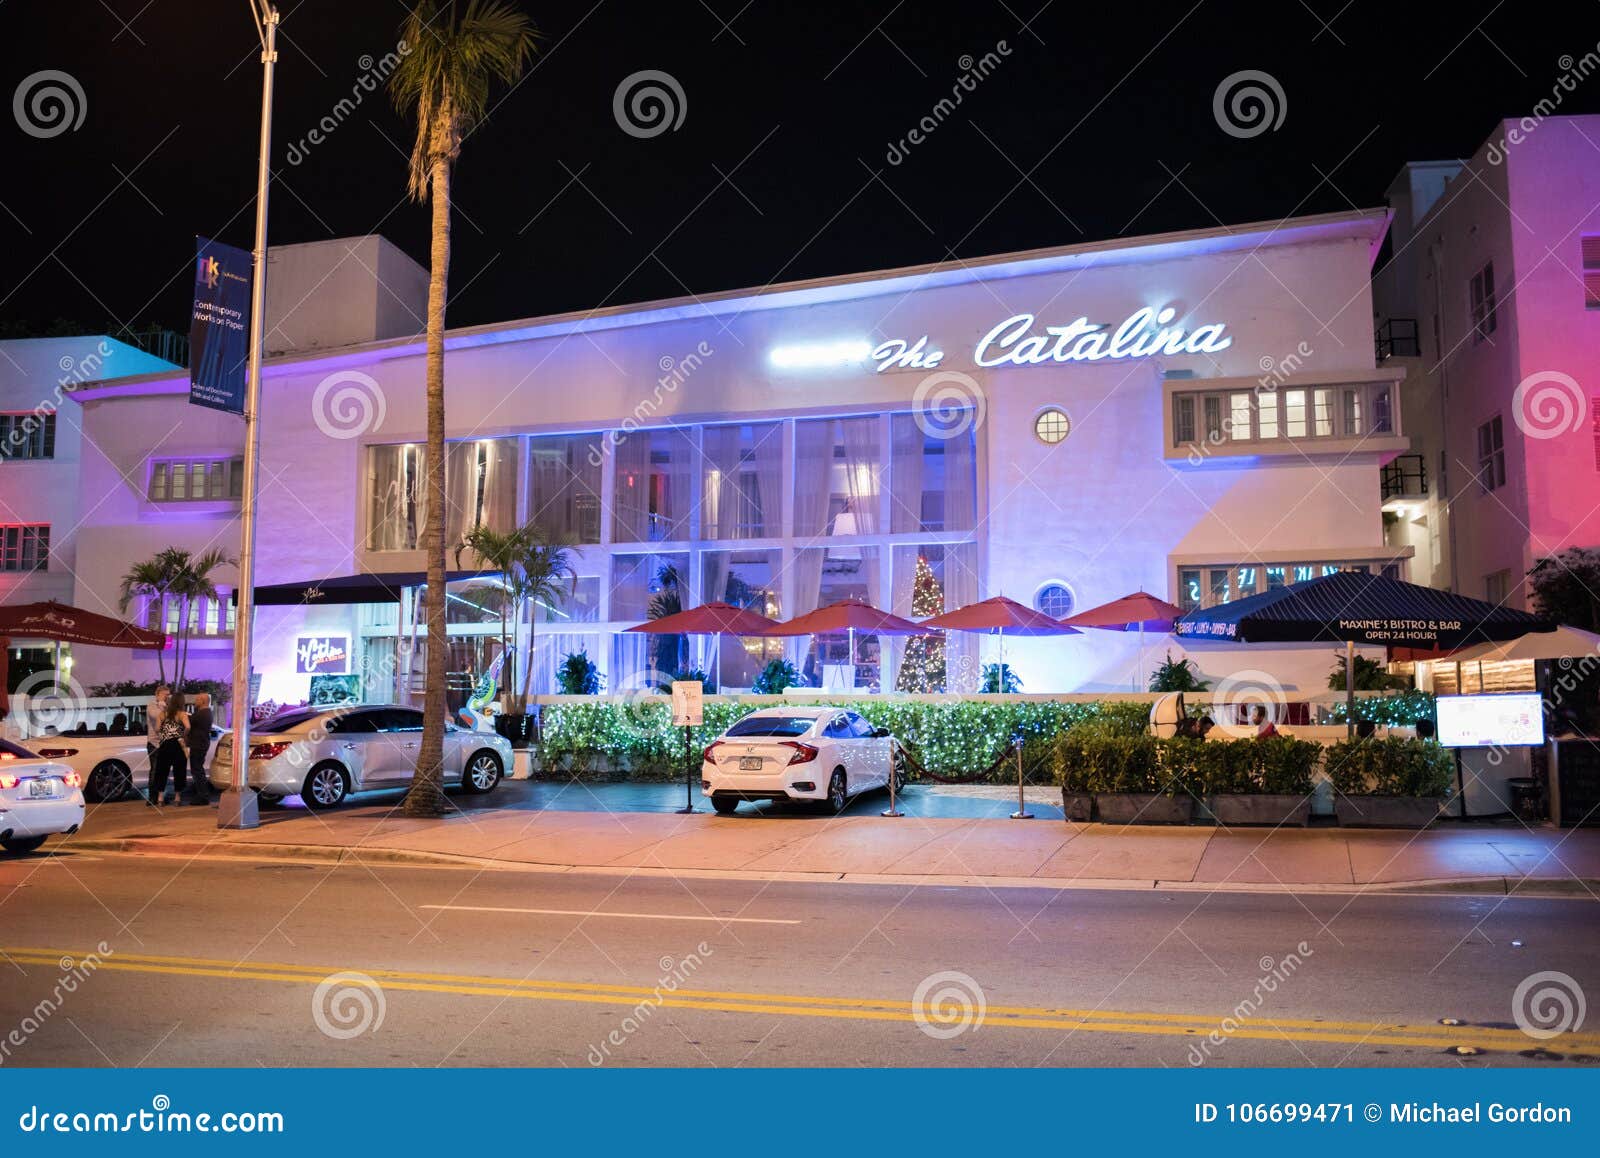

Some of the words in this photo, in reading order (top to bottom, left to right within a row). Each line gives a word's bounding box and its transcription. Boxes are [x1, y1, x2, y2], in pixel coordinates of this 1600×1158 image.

[195, 300, 242, 319] Contemporary
[194, 311, 215, 323] Works
[216, 318, 225, 326] on
[226, 319, 244, 330] Paper
[871, 336, 944, 372] The
[974, 306, 1232, 367] Catalina
[1340, 620, 1388, 629] MAXINE'S
[1390, 620, 1426, 630] BISTRO
[1428, 620, 1438, 630] &
[1440, 621, 1461, 630] BAR
[1365, 631, 1390, 639] OPEN
[1392, 631, 1404, 639] 24
[1406, 631, 1437, 640] HOURS
